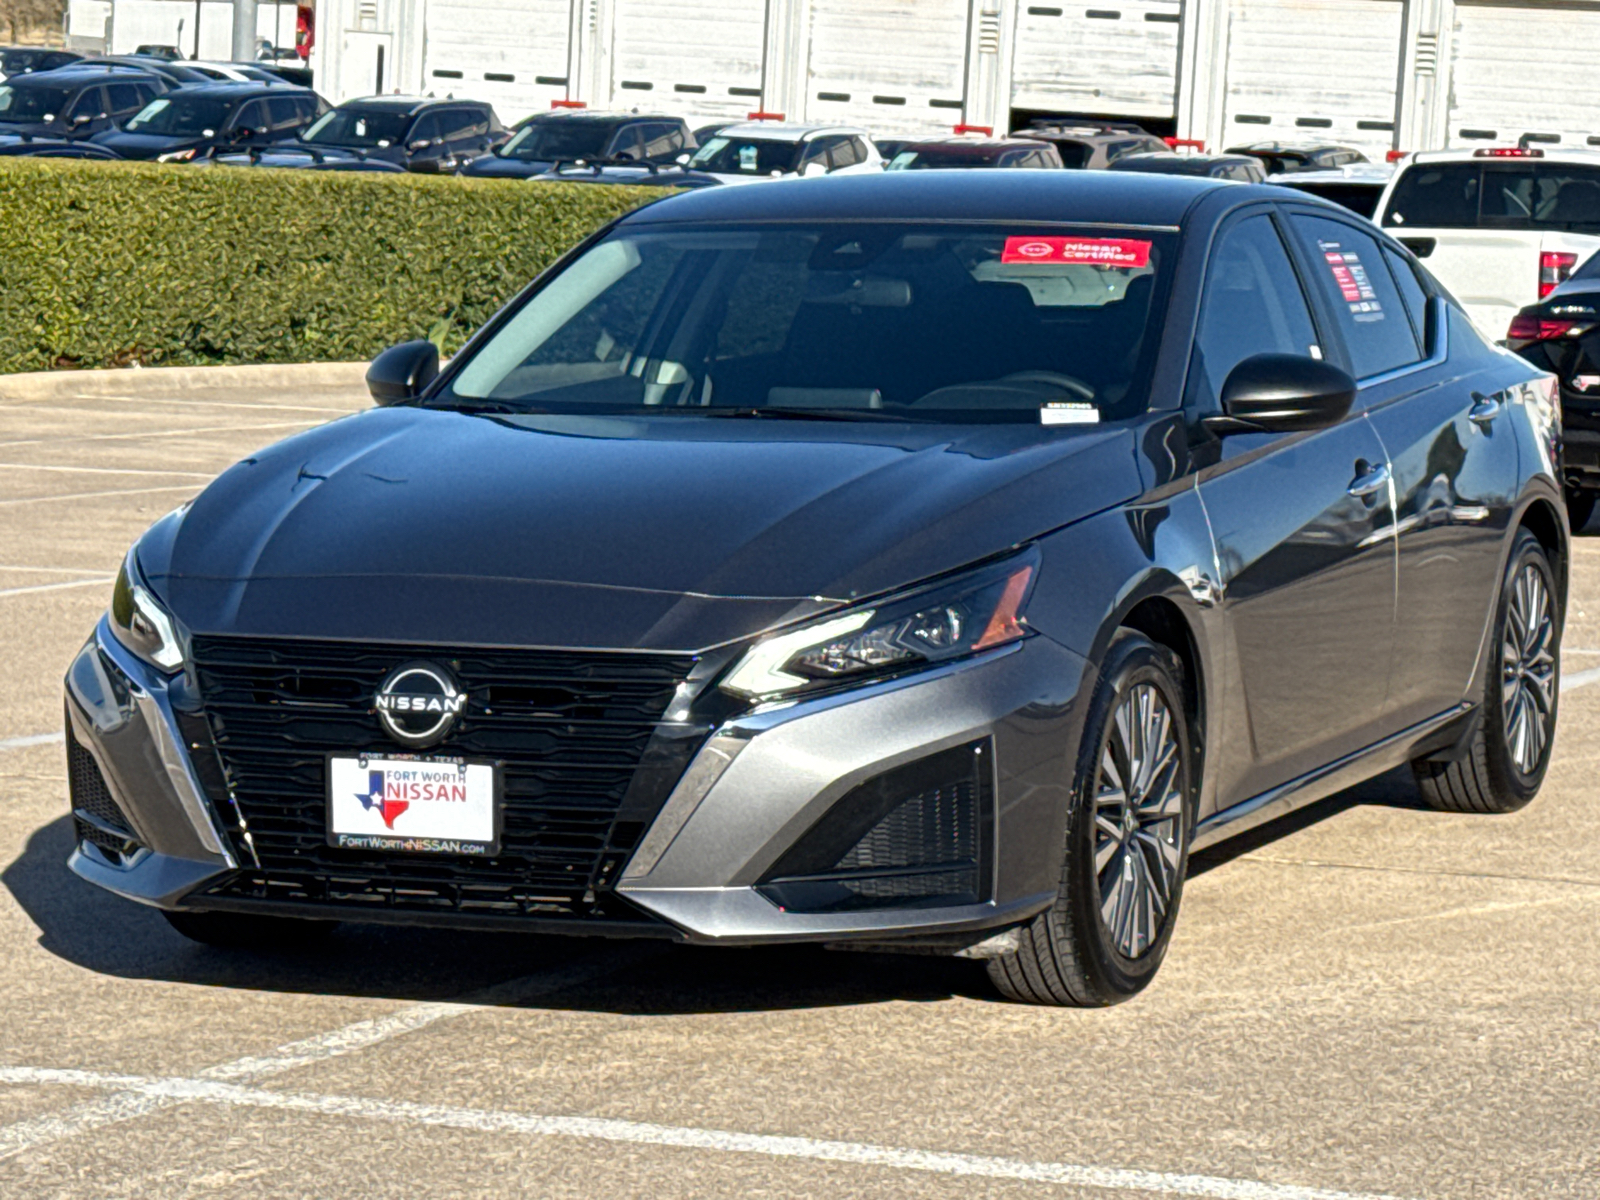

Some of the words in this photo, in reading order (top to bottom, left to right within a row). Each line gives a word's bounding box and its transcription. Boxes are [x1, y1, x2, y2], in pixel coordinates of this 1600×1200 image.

[375, 694, 460, 712] NISSAN
[386, 770, 418, 782] FORT
[421, 771, 467, 784] WORTH
[386, 783, 467, 802] NISSAN
